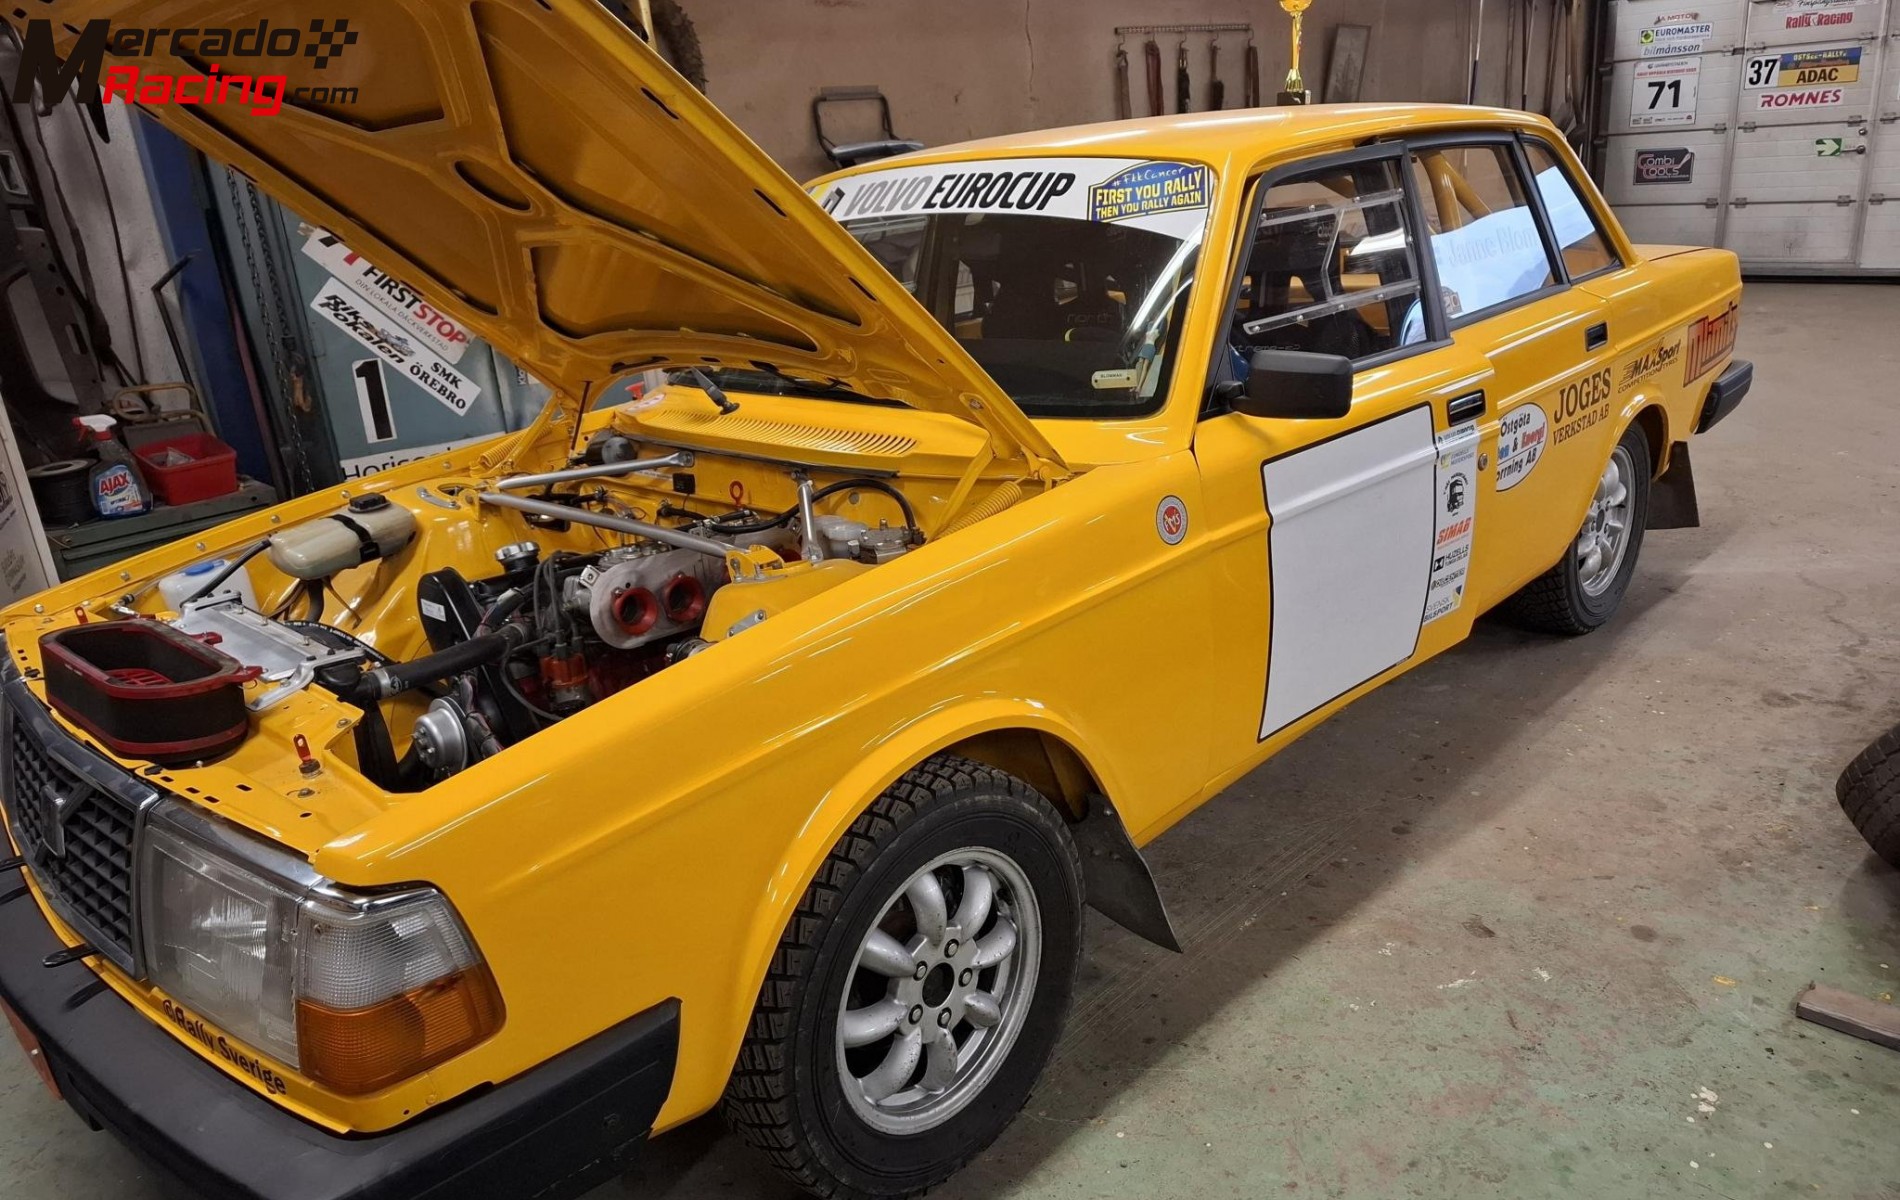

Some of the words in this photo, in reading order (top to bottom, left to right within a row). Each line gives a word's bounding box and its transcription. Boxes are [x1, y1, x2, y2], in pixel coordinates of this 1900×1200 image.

[1655, 25, 1711, 37] EUROMASTER
[1785, 15, 1811, 29] Rally
[1817, 12, 1853, 26] Racing
[1643, 44, 1701, 56] bilmånsson
[1748, 58, 1779, 86] 37
[1796, 68, 1839, 84] ADAC
[1648, 79, 1681, 110] 71
[1761, 89, 1842, 108] ROMNES
[843, 175, 934, 217] VOLVO
[921, 171, 1077, 211] EUROCUP
[1095, 188, 1133, 207] FIRST
[1136, 182, 1161, 200] YOU
[1164, 169, 1202, 196] RALLY
[1095, 205, 1119, 220] THEN
[1121, 202, 1139, 214] YOU
[1141, 197, 1169, 211] RALLY
[1171, 191, 1202, 207] AGAIN
[355, 278, 370, 292] DIN
[362, 265, 470, 344] FIRSTSTOP
[409, 361, 466, 410] ÖREBRO
[430, 362, 463, 389] SMK
[355, 359, 393, 440] 1
[1554, 367, 1611, 424] JOGES
[1500, 412, 1531, 437] Östgöta
[1553, 410, 1598, 446] VERKSTAD
[1599, 403, 1610, 421] AB
[1512, 437, 1518, 452] &
[1526, 447, 1537, 466] AB
[99, 471, 129, 494] AJAX
[217, 1036, 287, 1095] Sverige
